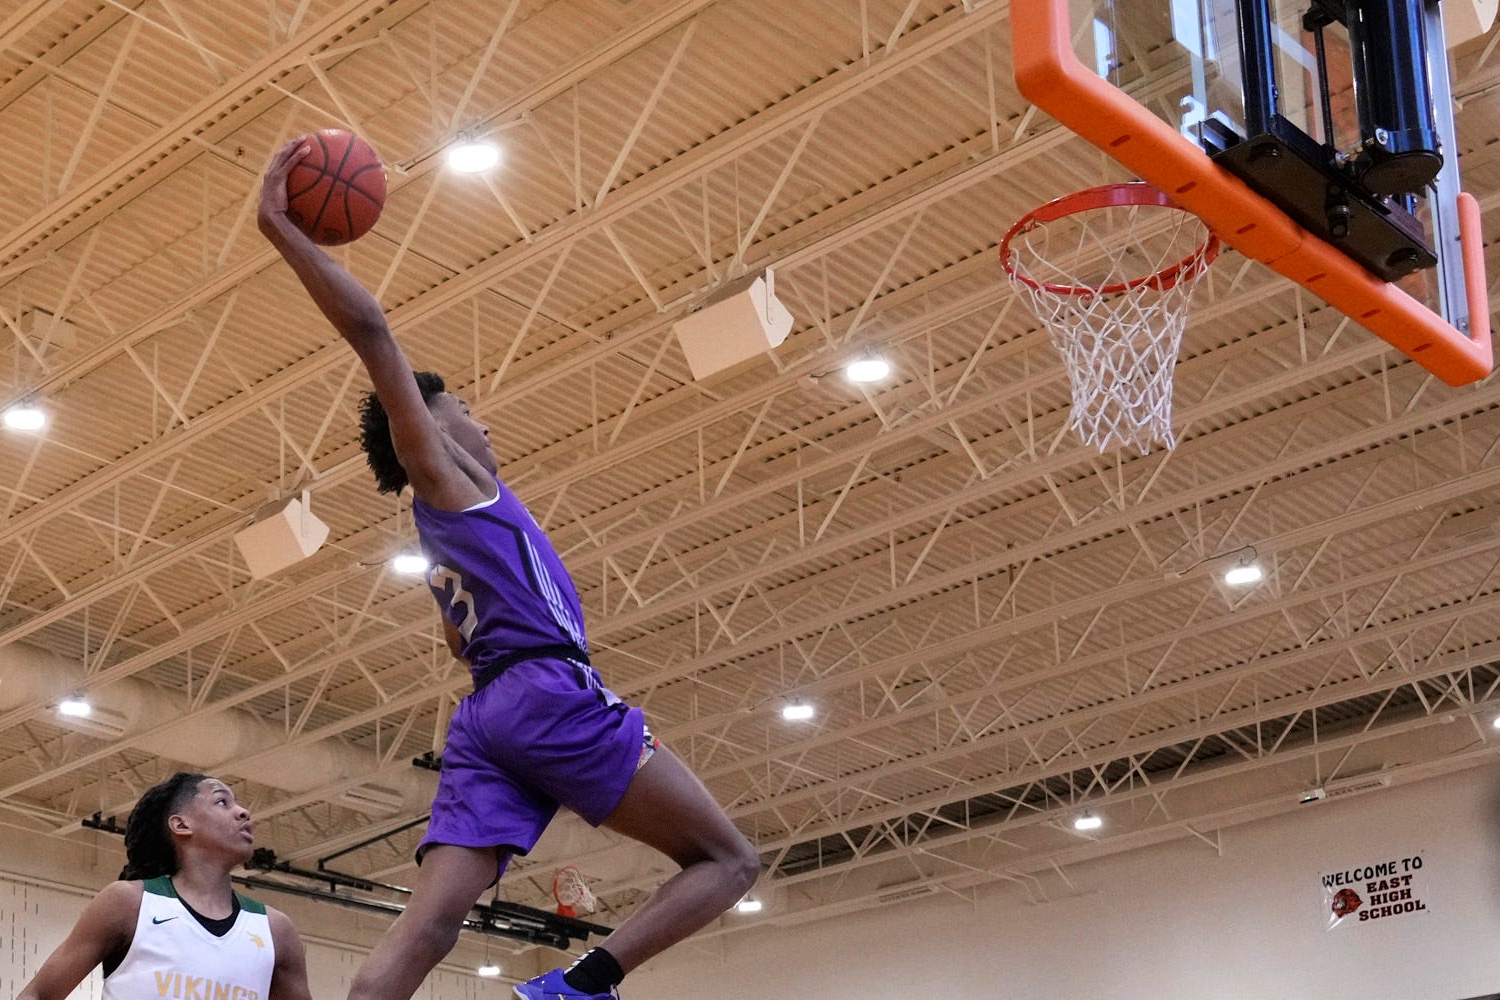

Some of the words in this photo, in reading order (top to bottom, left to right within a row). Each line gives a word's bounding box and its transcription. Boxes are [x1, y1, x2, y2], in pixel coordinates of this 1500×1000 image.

[1322, 861, 1397, 888] WELCOME
[1402, 856, 1423, 872] TO
[1366, 875, 1413, 893] EAST
[1370, 888, 1412, 906] HIGH
[1359, 900, 1426, 921] SCHOOL
